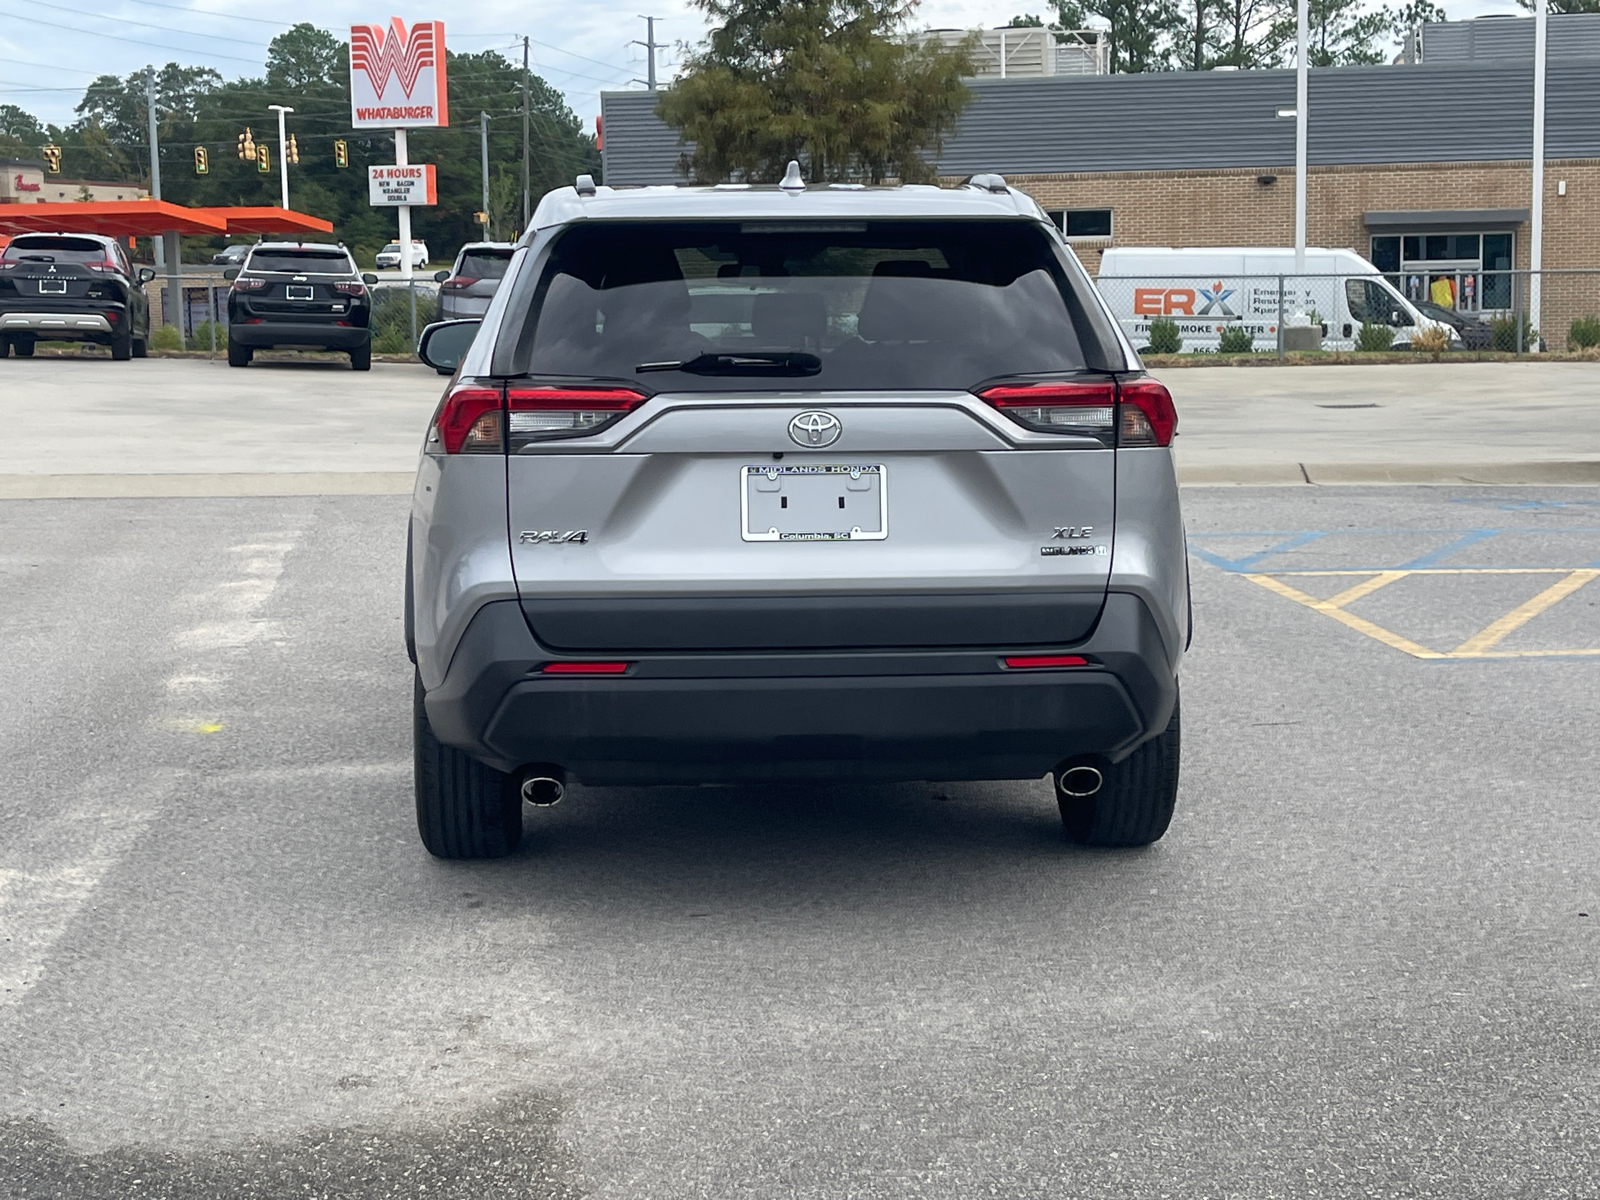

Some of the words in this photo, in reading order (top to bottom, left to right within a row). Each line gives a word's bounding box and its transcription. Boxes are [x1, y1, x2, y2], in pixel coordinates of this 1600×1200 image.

[356, 105, 434, 121] WHATABURGER
[372, 169, 384, 179] 24
[386, 168, 422, 179] HOURS
[1134, 287, 1237, 316] ERX
[1178, 325, 1212, 333] MOKE
[759, 465, 826, 474] MIDLANDS
[831, 465, 878, 474] HONDA
[519, 529, 589, 545] RAV4
[834, 532, 849, 540] SC
[1051, 526, 1094, 540] XLE
